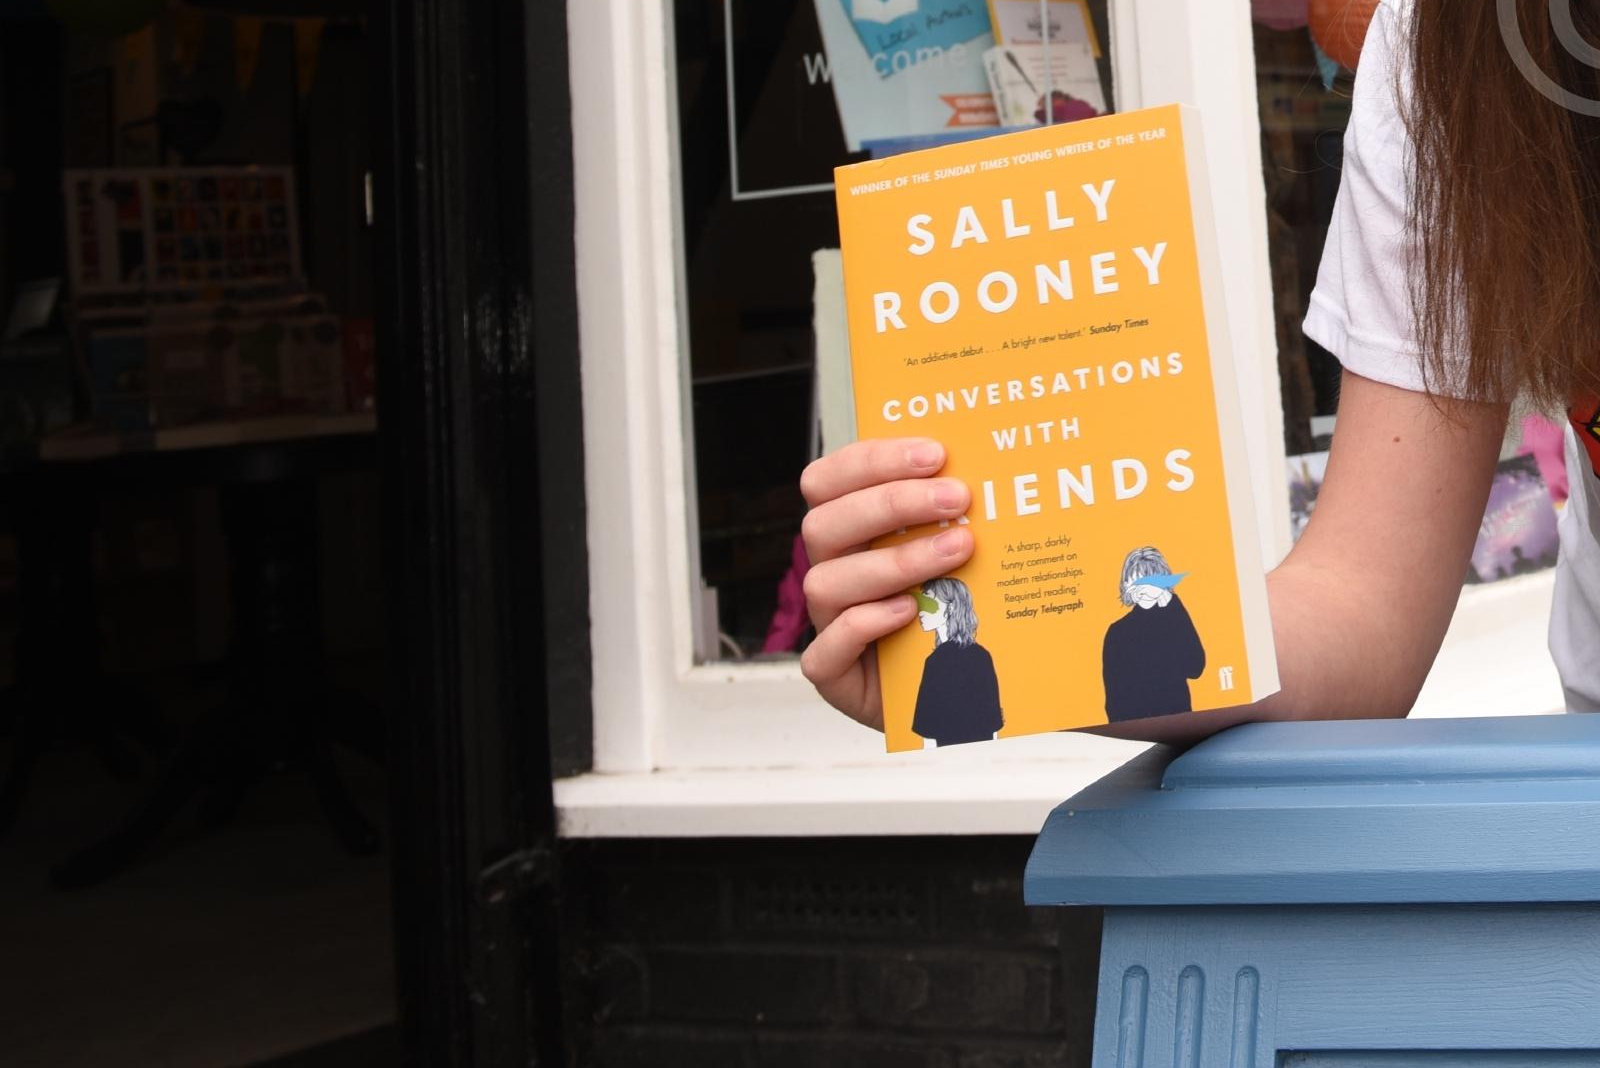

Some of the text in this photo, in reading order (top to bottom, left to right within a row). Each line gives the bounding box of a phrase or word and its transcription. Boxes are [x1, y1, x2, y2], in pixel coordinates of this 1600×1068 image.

[803, 43, 968, 85] wcome
[850, 128, 1167, 197] WINNER OF THE SUNDAY TIMES YOUNG WRITER OF THE YEAR
[906, 179, 1117, 256] SALLY
[873, 242, 1168, 333] ROONEY
[920, 349, 958, 365] addictive
[959, 345, 984, 359] debut
[1011, 336, 1037, 352] bright
[1039, 333, 1056, 343] new
[1089, 322, 1122, 336] Sunday
[1124, 318, 1149, 329] Times
[882, 352, 1184, 421] CONVERSATIONS
[991, 417, 1080, 451] WITH
[899, 448, 1195, 535] IENDS
[1045, 534, 1071, 547] darkly
[997, 575, 1028, 587] modern
[1001, 560, 1024, 570] funny
[1026, 554, 1064, 567] comment
[1004, 588, 1041, 603] Required
[1006, 598, 1084, 619] Sunday Telegraph
